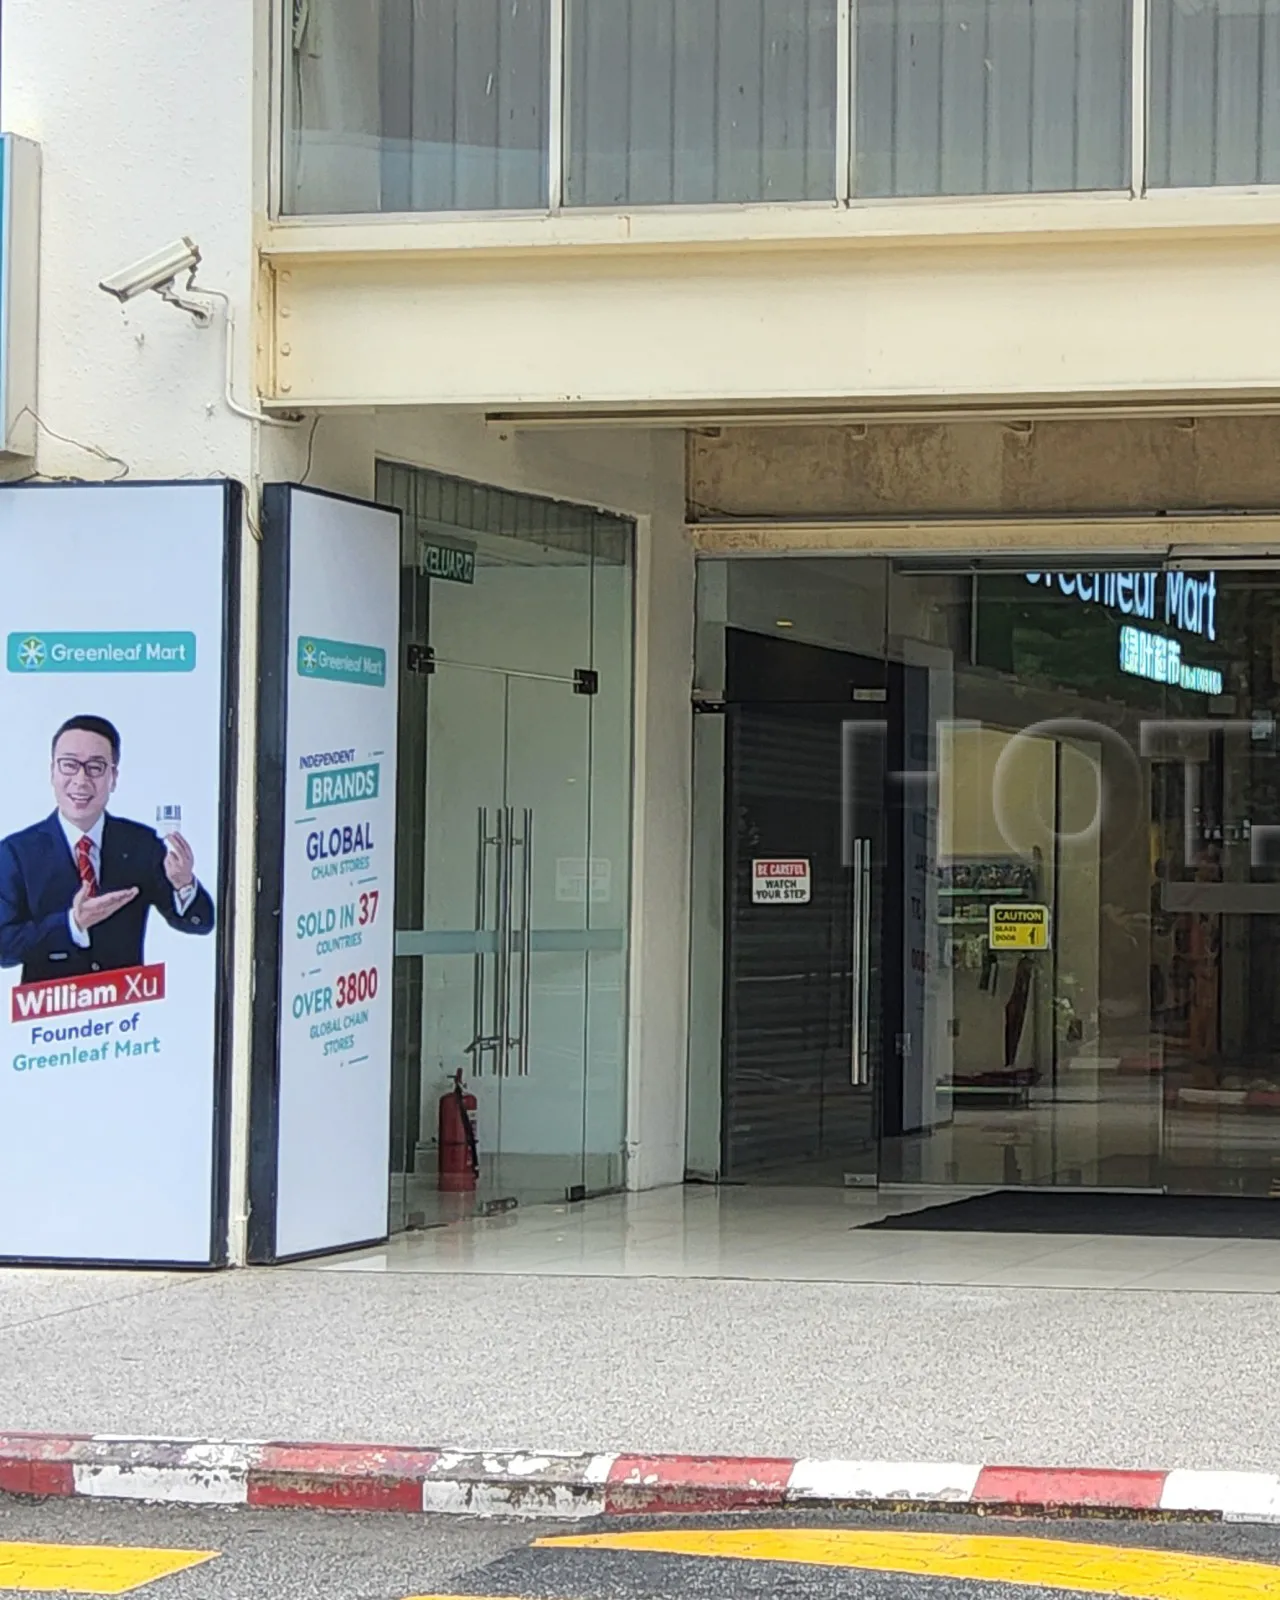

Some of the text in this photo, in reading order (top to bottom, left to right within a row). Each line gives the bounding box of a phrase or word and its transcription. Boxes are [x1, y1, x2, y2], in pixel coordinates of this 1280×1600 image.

[1165, 571, 1217, 641] Mart
[51, 642, 187, 662] Greenleaf Mart
[318, 650, 363, 673] Greenleaf
[299, 748, 356, 770] INDEPENDENT
[311, 769, 375, 805] BRANDS
[306, 821, 374, 861] GLOBAL
[311, 855, 371, 881] CHAIN STORES
[769, 863, 805, 876] CAREFUL
[755, 889, 807, 900] YOUR STEP
[765, 879, 797, 889] WATCH
[296, 890, 379, 940] SOLD IN 37
[996, 911, 1042, 921] CAUTION
[316, 931, 363, 957] COUNTRIES
[15, 972, 158, 1017] William Xu
[292, 966, 379, 1020] OVER 3800
[31, 1011, 141, 1045] Founder of
[309, 1008, 370, 1040] GLOBAL CHAIN
[12, 1036, 162, 1072] Greenleaf Mart
[322, 1034, 355, 1057] STORES
